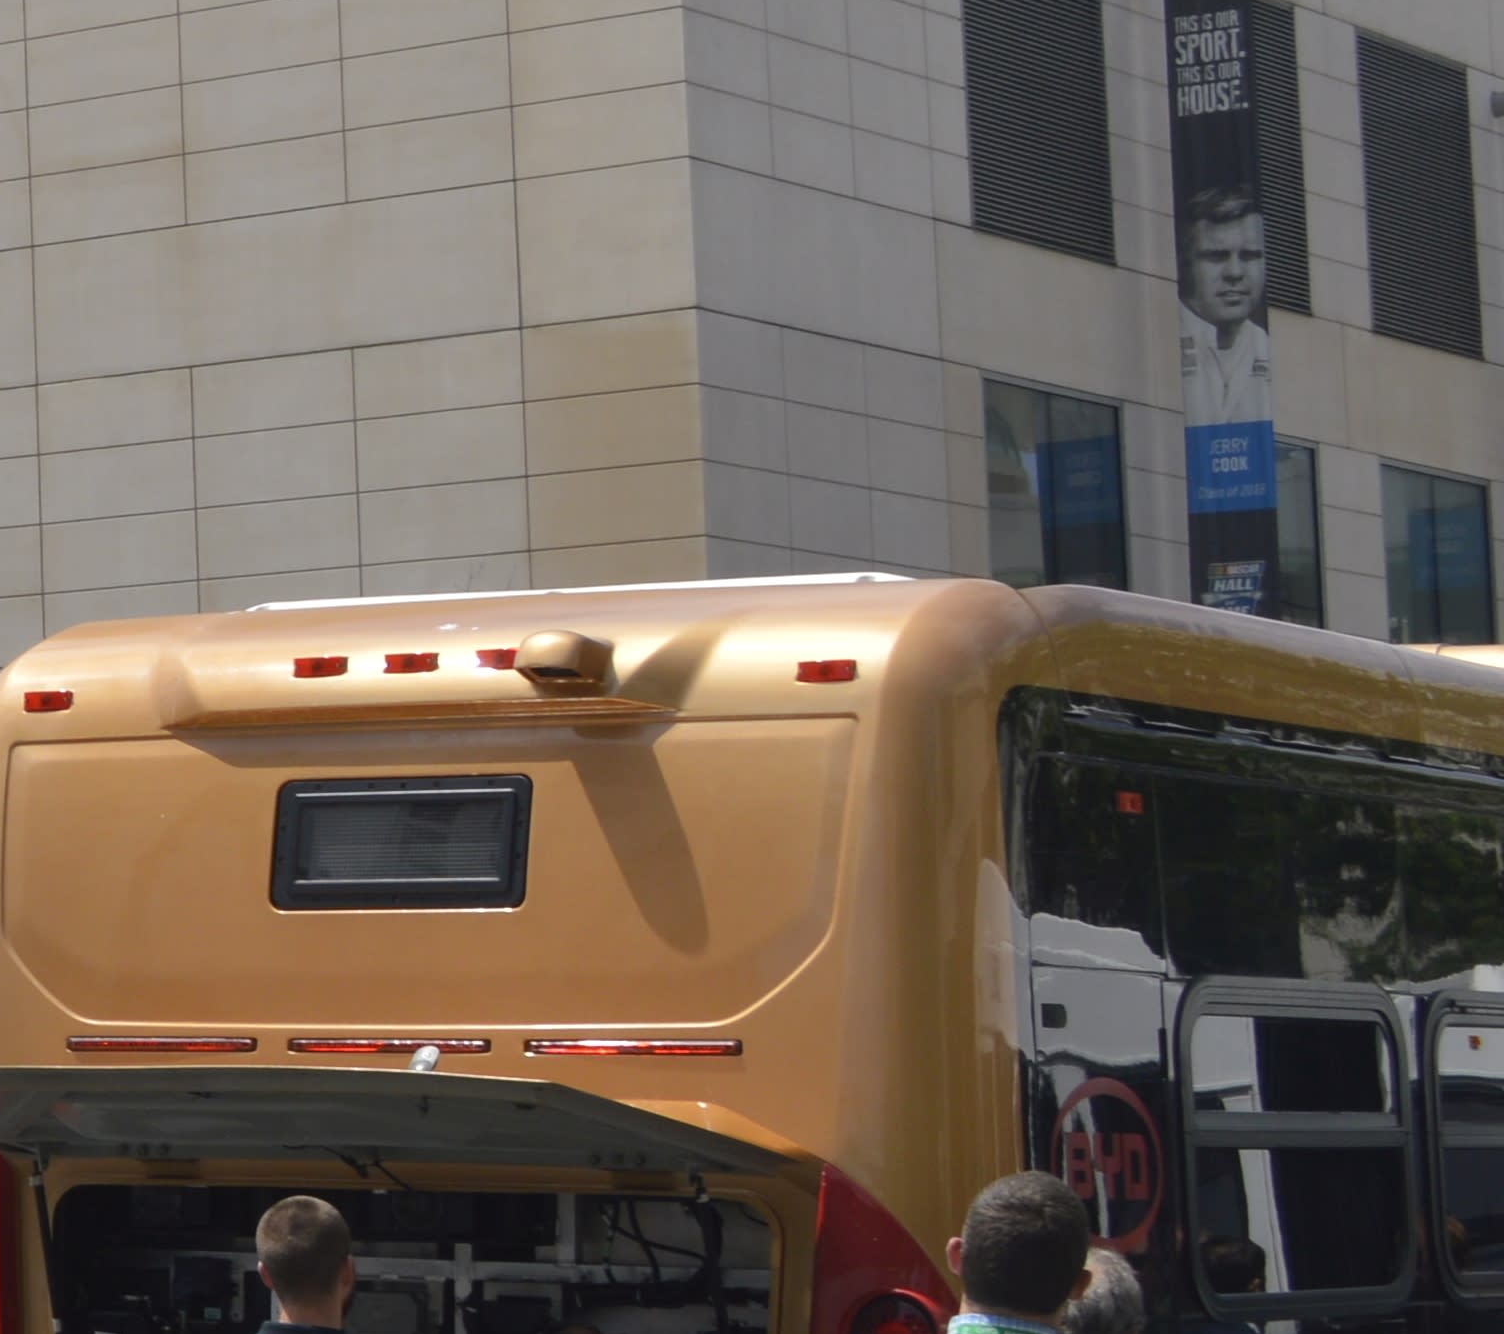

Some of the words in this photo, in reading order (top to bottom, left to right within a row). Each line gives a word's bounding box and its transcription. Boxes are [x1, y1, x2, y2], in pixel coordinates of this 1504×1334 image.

[1173, 14, 1199, 34] THIS
[1201, 12, 1214, 30] IS
[1215, 9, 1240, 28] OUR
[1174, 27, 1246, 65] SPORT.
[1176, 65, 1201, 84] THIS
[1204, 63, 1216, 81] IS
[1217, 60, 1241, 79] OUR
[1176, 79, 1249, 118] HOUSE.
[1210, 436, 1249, 455] JERRY
[1211, 456, 1249, 474] COOK
[1214, 578, 1255, 592] HALL
[1066, 1131, 1151, 1201] BYD
